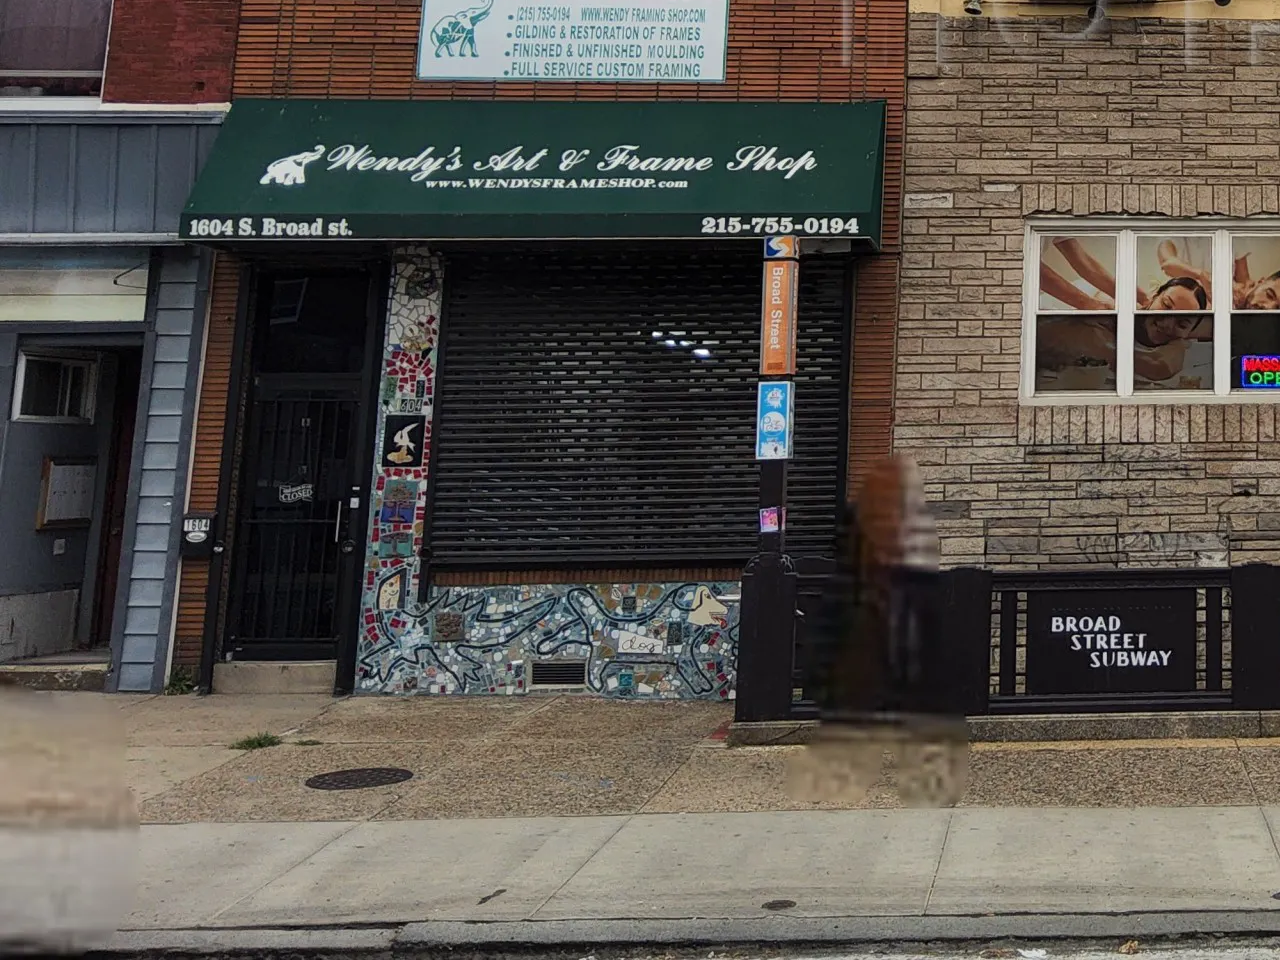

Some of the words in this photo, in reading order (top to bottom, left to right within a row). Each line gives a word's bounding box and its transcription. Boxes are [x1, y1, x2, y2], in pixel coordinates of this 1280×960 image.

[516, 7, 536, 22] (215)
[537, 6, 571, 22] 755-0194
[515, 25, 556, 40] GILDING
[560, 26, 566, 39] &
[570, 25, 640, 41] RESTORATION
[642, 26, 656, 40] OF
[660, 26, 701, 41] FRAMES
[512, 43, 562, 58] FINISHED
[566, 44, 574, 58] &
[577, 44, 643, 59] UNFINISHED
[647, 44, 705, 60] MOULDING
[511, 62, 540, 77] FULL
[543, 62, 593, 77] SERVICE
[596, 62, 645, 78] CUSTOM
[649, 63, 701, 78] FRAMING
[327, 144, 463, 182] Wendy's
[473, 145, 548, 171] Art
[558, 149, 590, 171] &
[596, 144, 713, 172] Frame
[726, 145, 818, 179] Shop
[425, 177, 689, 189] www.WENDYSFRAMESHOP.com
[189, 218, 233, 235] 1604
[238, 217, 256, 236] S.
[261, 217, 323, 235] Broad
[327, 218, 353, 235] st.
[701, 216, 859, 234] 215-755-0194
[770, 266, 784, 305] Broad
[770, 309, 783, 350] Street
[282, 489, 313, 501] CLOSED
[187, 518, 208, 531] 1604
[1051, 616, 1121, 633] BROAD
[1070, 633, 1148, 651] STREET
[1089, 650, 1172, 668] SUBWAY
